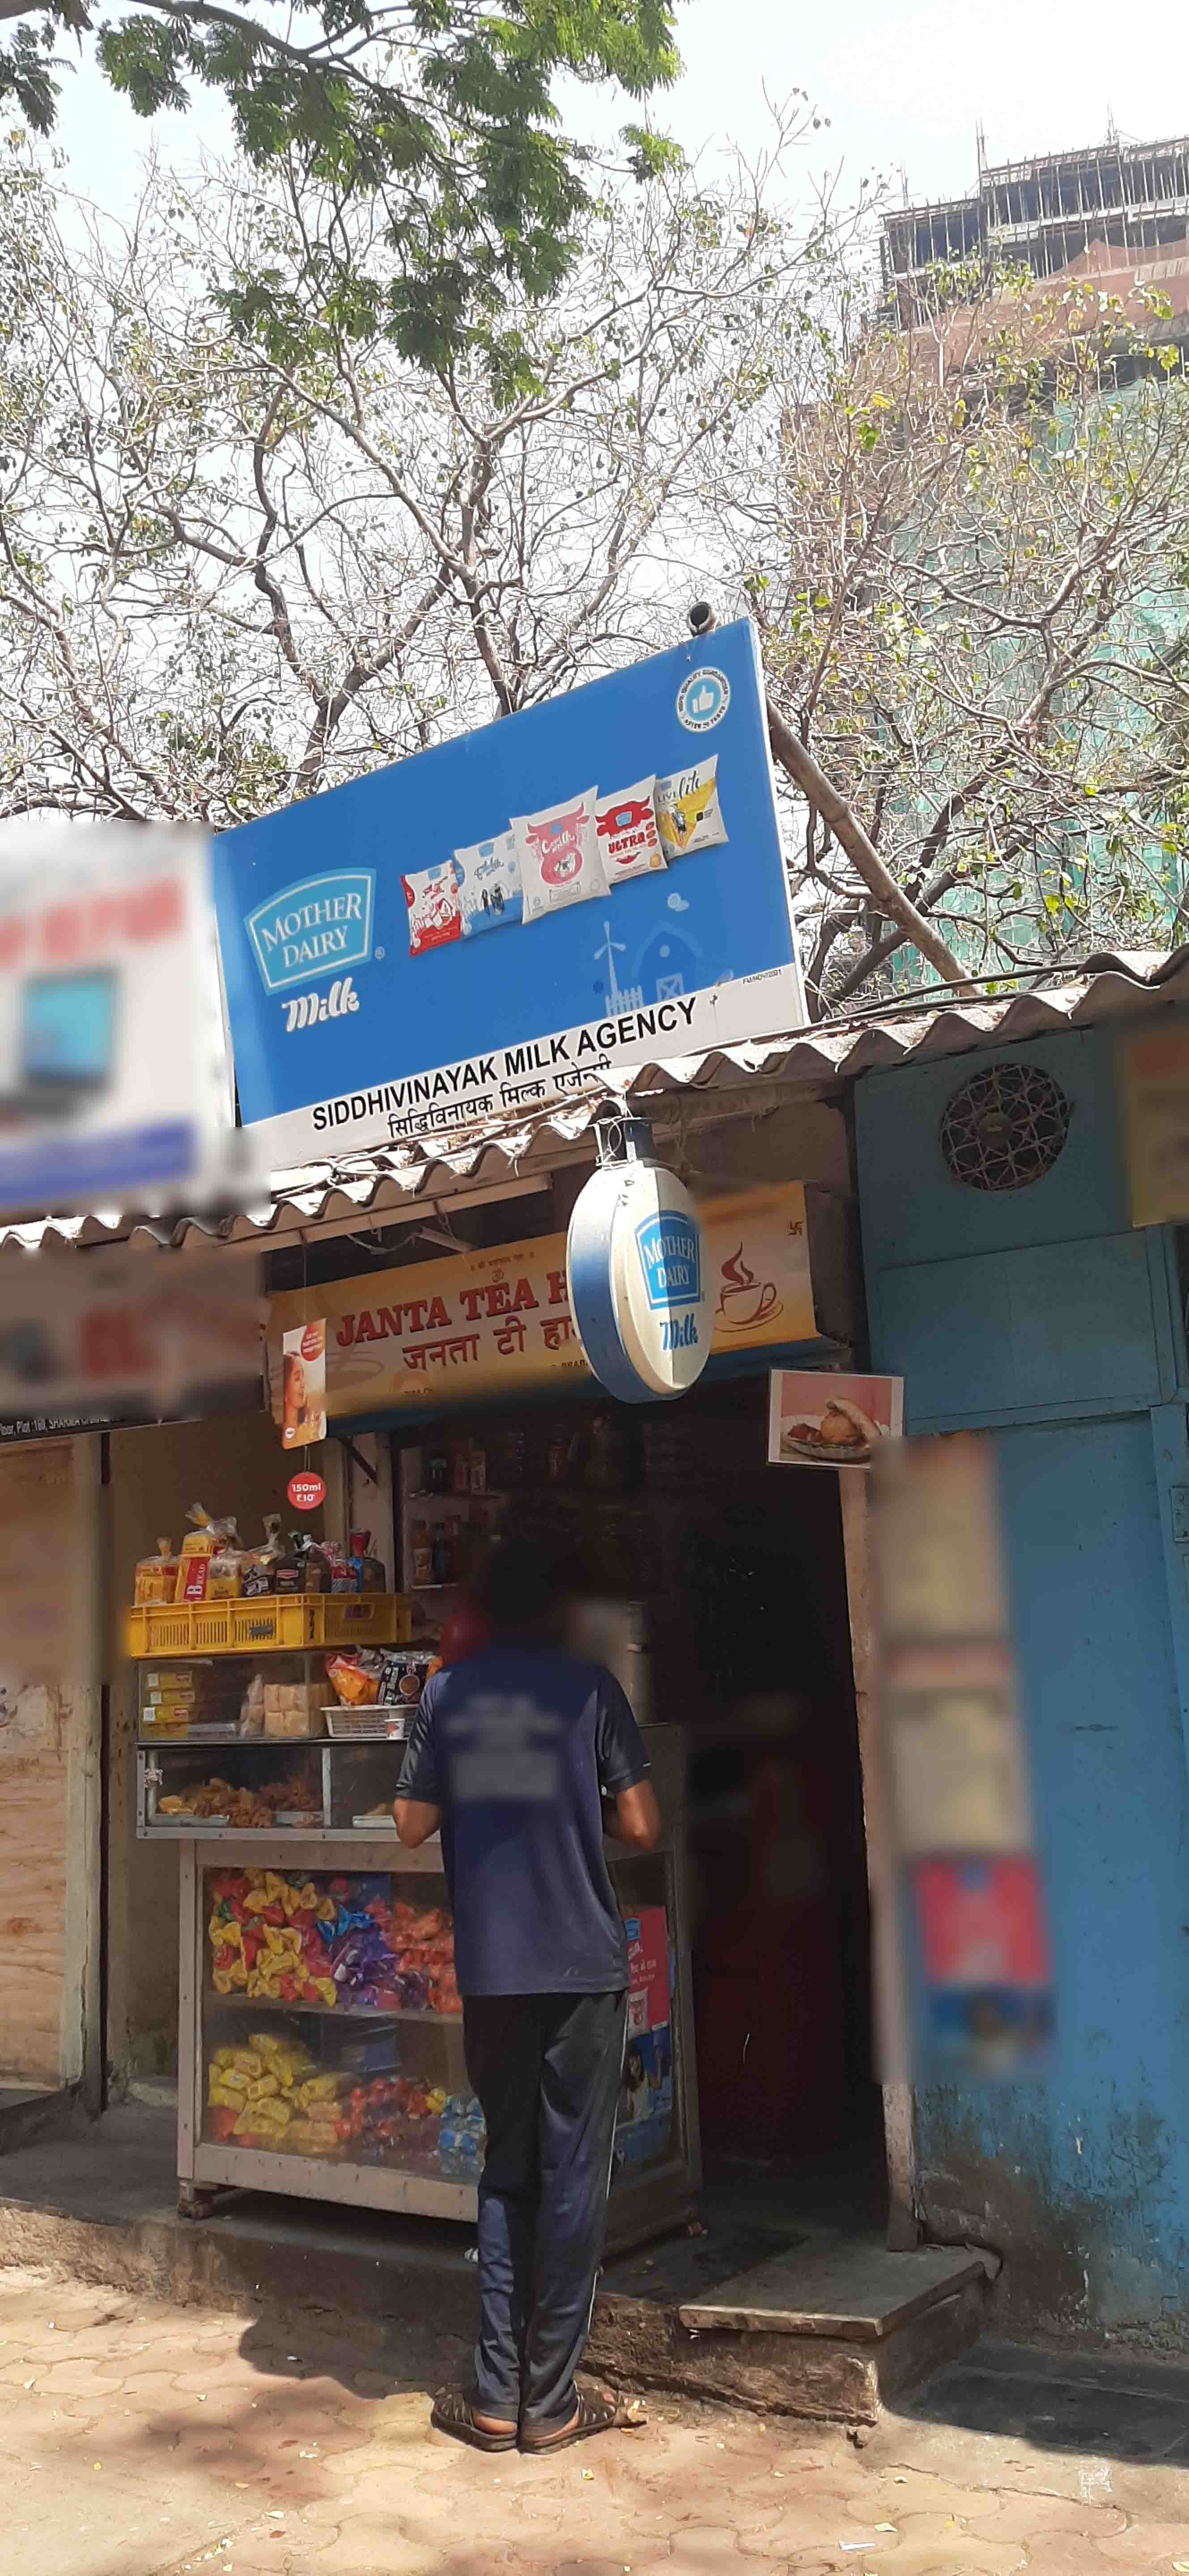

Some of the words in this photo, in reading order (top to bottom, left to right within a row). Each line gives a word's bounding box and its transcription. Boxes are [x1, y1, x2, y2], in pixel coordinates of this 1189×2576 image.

[608, 832, 645, 854] ULTRA
[261, 893, 362, 952] MOTHER
[283, 925, 348, 967] DAIRY
[281, 977, 360, 1032] Milk
[313, 1056, 498, 1131] SIDDHIVINAYAK
[505, 1035, 570, 1076] MILK
[577, 997, 696, 1056] AGENCY
[500, 1080, 545, 1107] मिल्क
[644, 1236, 695, 1269] MOTHER
[656, 1264, 689, 1288] DAIRY
[336, 1296, 452, 1347] JANTA
[459, 1278, 539, 1321] TEA
[659, 1313, 698, 1351] Milk
[403, 1333, 480, 1371] जनता
[494, 1315, 526, 1355] टी
[292, 1483, 321, 1492] 150ml
